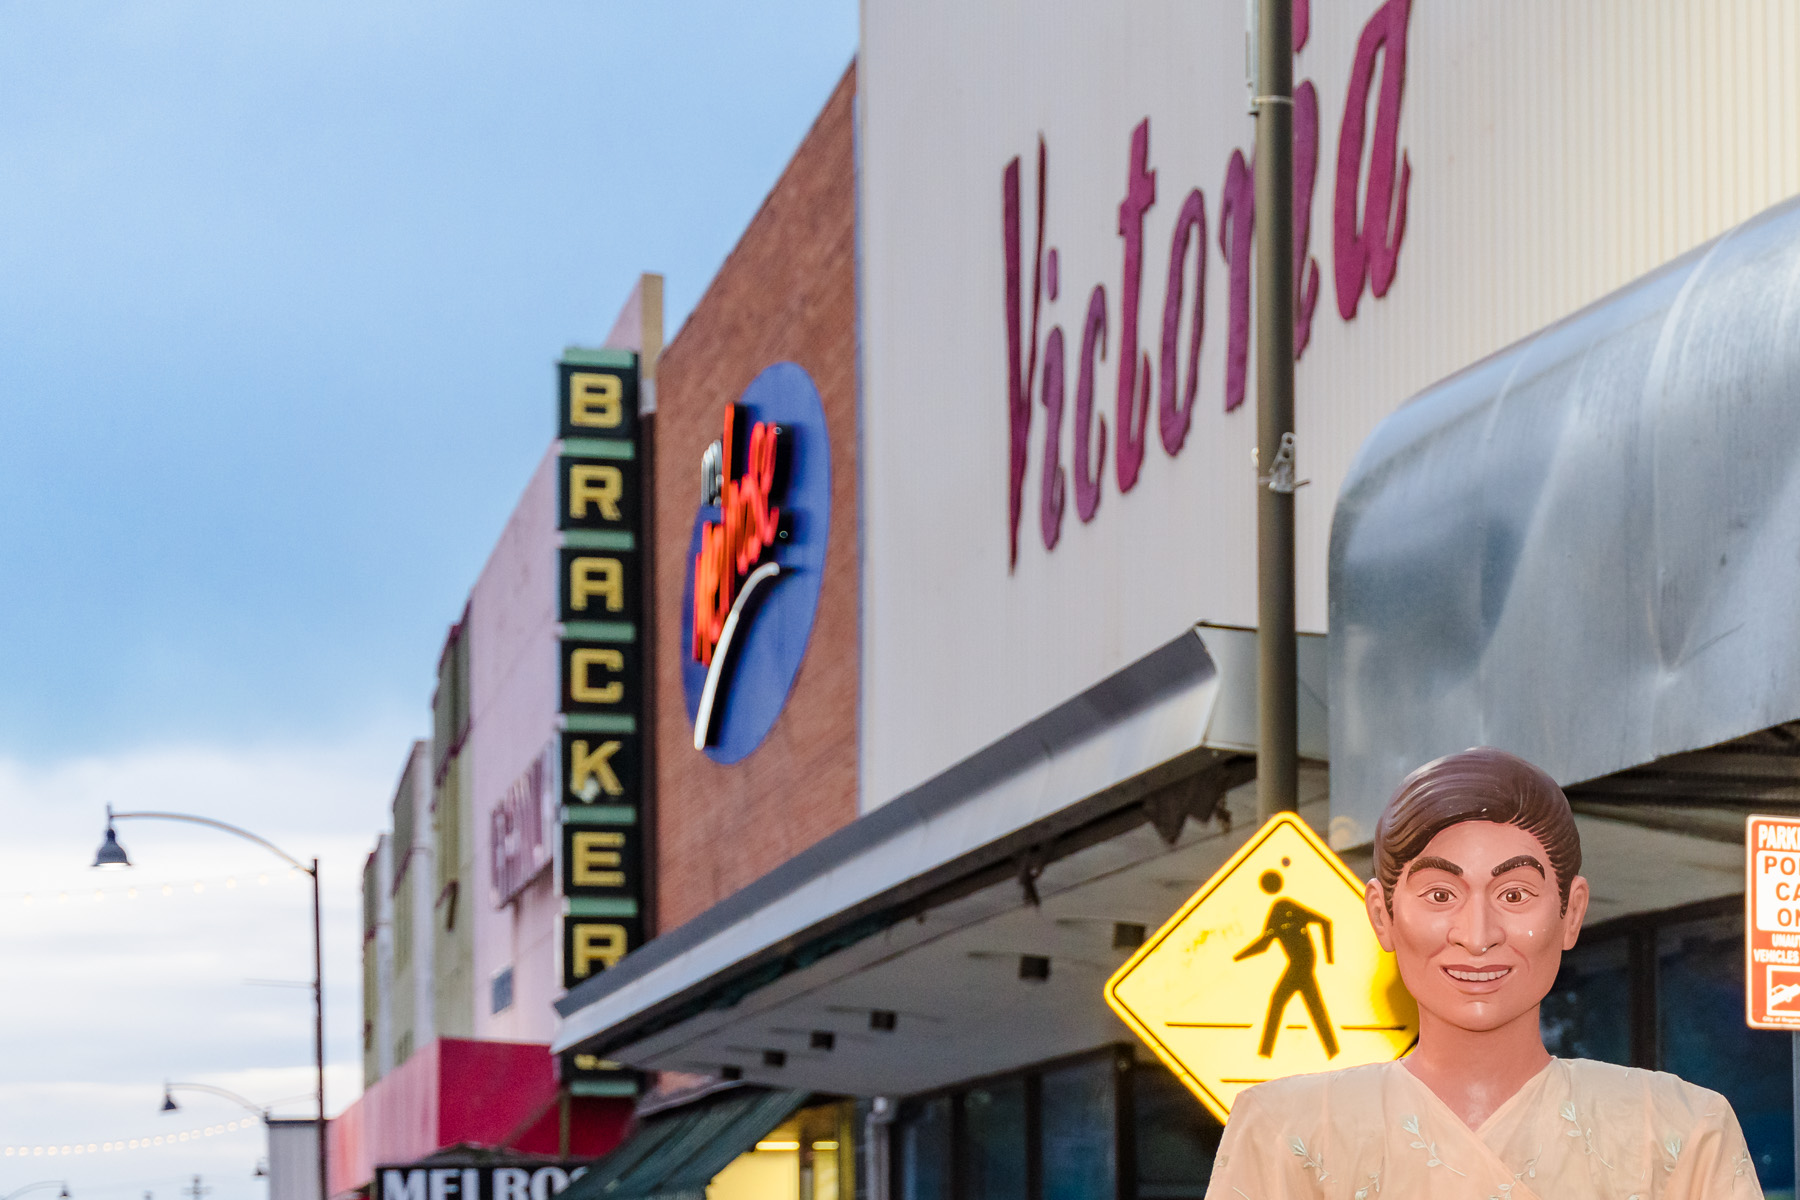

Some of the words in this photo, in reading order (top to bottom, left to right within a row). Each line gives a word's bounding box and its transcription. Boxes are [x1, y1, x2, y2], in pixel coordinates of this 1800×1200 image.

[1000, 0, 1413, 577] Victoria
[568, 372, 630, 1070] BRACKER
[1753, 949, 1800, 964] VEHICLES
